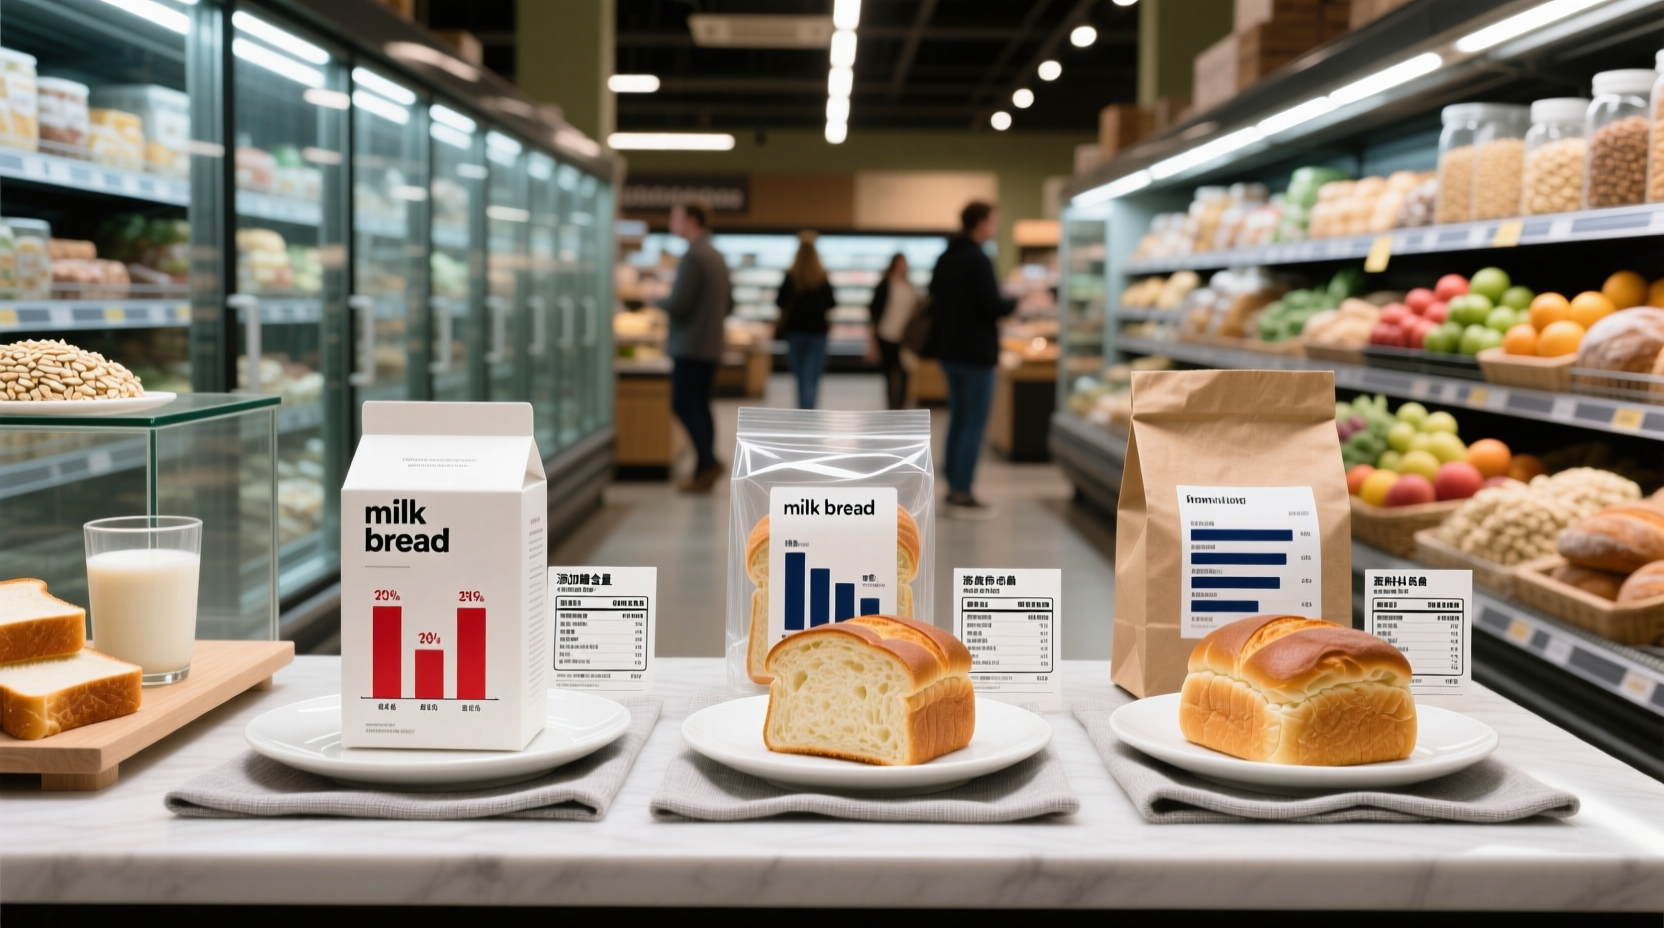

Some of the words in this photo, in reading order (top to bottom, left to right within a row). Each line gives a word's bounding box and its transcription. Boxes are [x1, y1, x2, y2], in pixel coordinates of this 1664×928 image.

[365, 498, 426, 524] milk
[784, 498, 820, 516] milk
[825, 498, 875, 516] bread
[365, 527, 449, 553] bread
